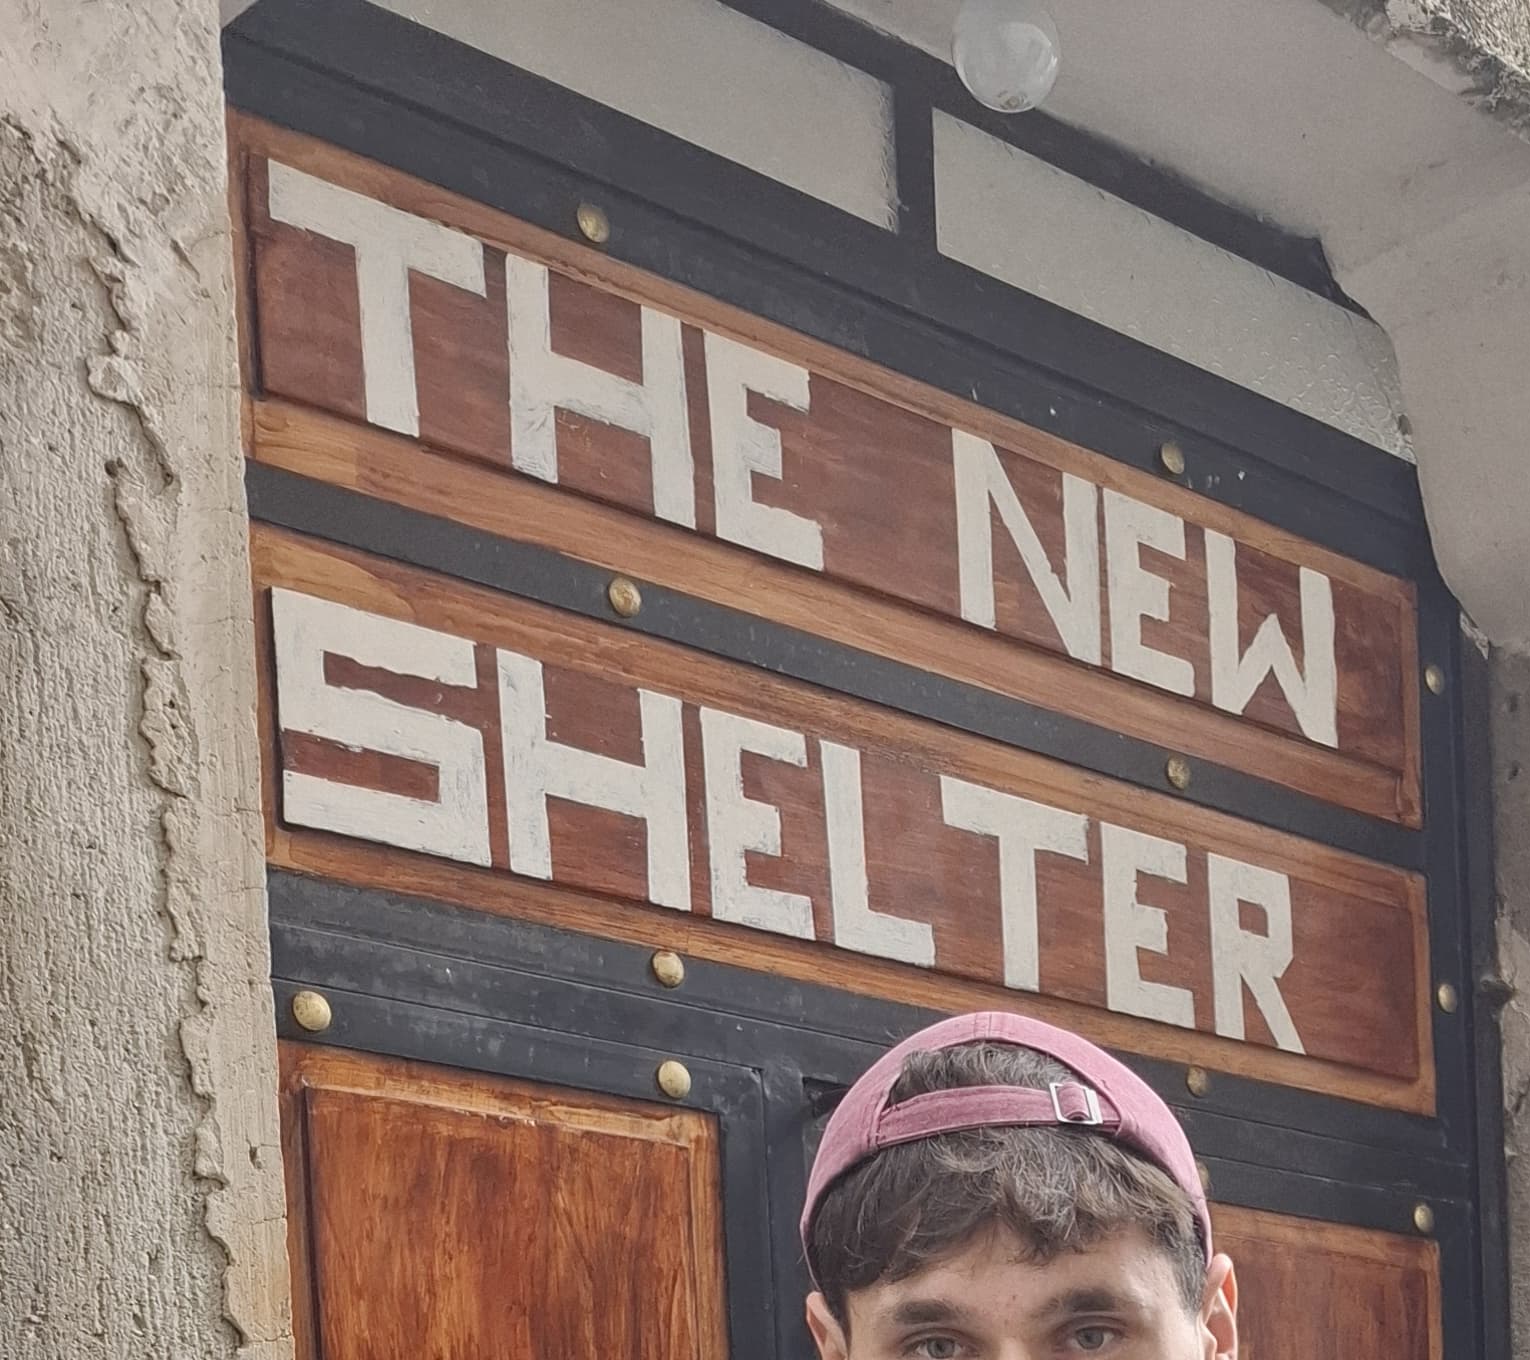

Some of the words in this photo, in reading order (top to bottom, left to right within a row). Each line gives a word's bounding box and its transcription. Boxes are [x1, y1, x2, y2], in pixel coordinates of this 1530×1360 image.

[268, 158, 824, 571] THE
[951, 428, 1339, 749] NEW
[271, 586, 1306, 1054] SHELTER
